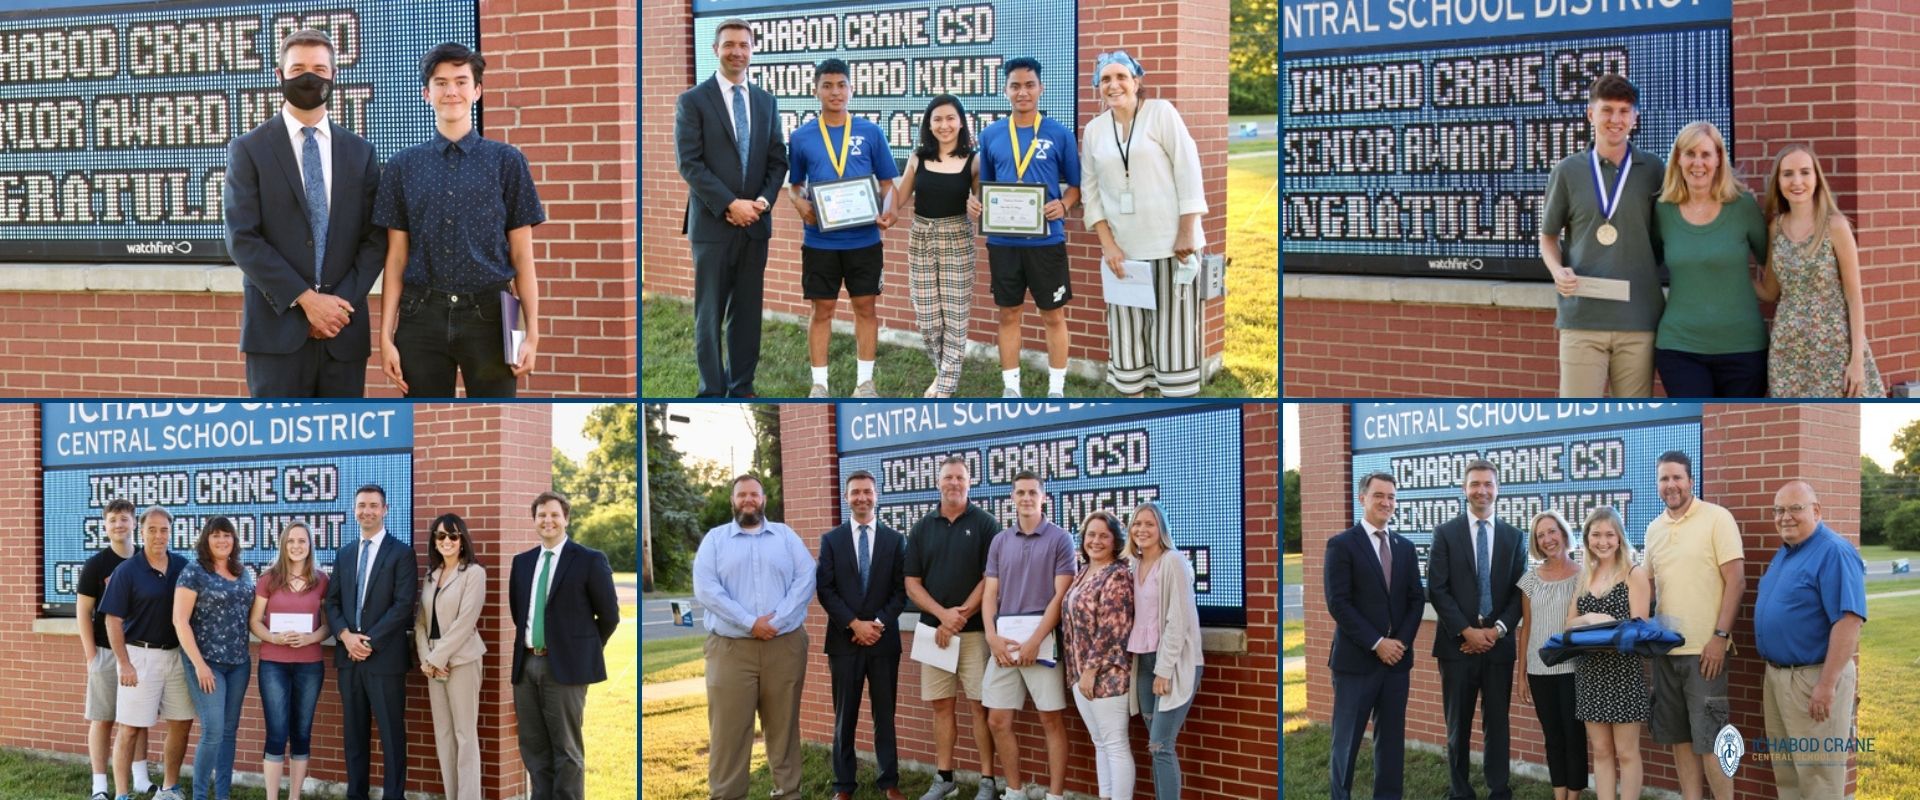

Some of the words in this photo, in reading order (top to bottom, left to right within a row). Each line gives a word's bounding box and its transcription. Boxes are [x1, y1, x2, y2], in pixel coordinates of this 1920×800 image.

[130, 19, 261, 75] CRANE
[273, 13, 359, 66] CD
[844, 10, 929, 49] CRANE
[937, 5, 993, 44] CSD
[914, 58, 1001, 95] NIGHT
[1291, 63, 1423, 113] ICHABOD
[1433, 56, 1543, 106] CRANE
[96, 95, 228, 147] AWARD
[1284, 128, 1395, 173] SENIOR
[1404, 125, 1515, 171] AWARD
[1283, 196, 1544, 240] NGRATULAT
[126, 241, 174, 254] watchfire
[1428, 258, 1468, 270] watchfire
[57, 427, 157, 457] CENTRAL
[163, 420, 263, 451] SCHOOL
[270, 410, 396, 445] DISTRICT
[851, 403, 947, 441] CENTRAL
[1364, 406, 1451, 440] CENTRAL
[1456, 403, 1550, 430] SCHOOL
[988, 439, 1078, 484] CRANE
[1085, 431, 1148, 475] CSD
[1571, 440, 1624, 479] CSD
[89, 473, 189, 507] ICHABOD
[195, 469, 277, 504] CRANE
[284, 466, 338, 501] CSD
